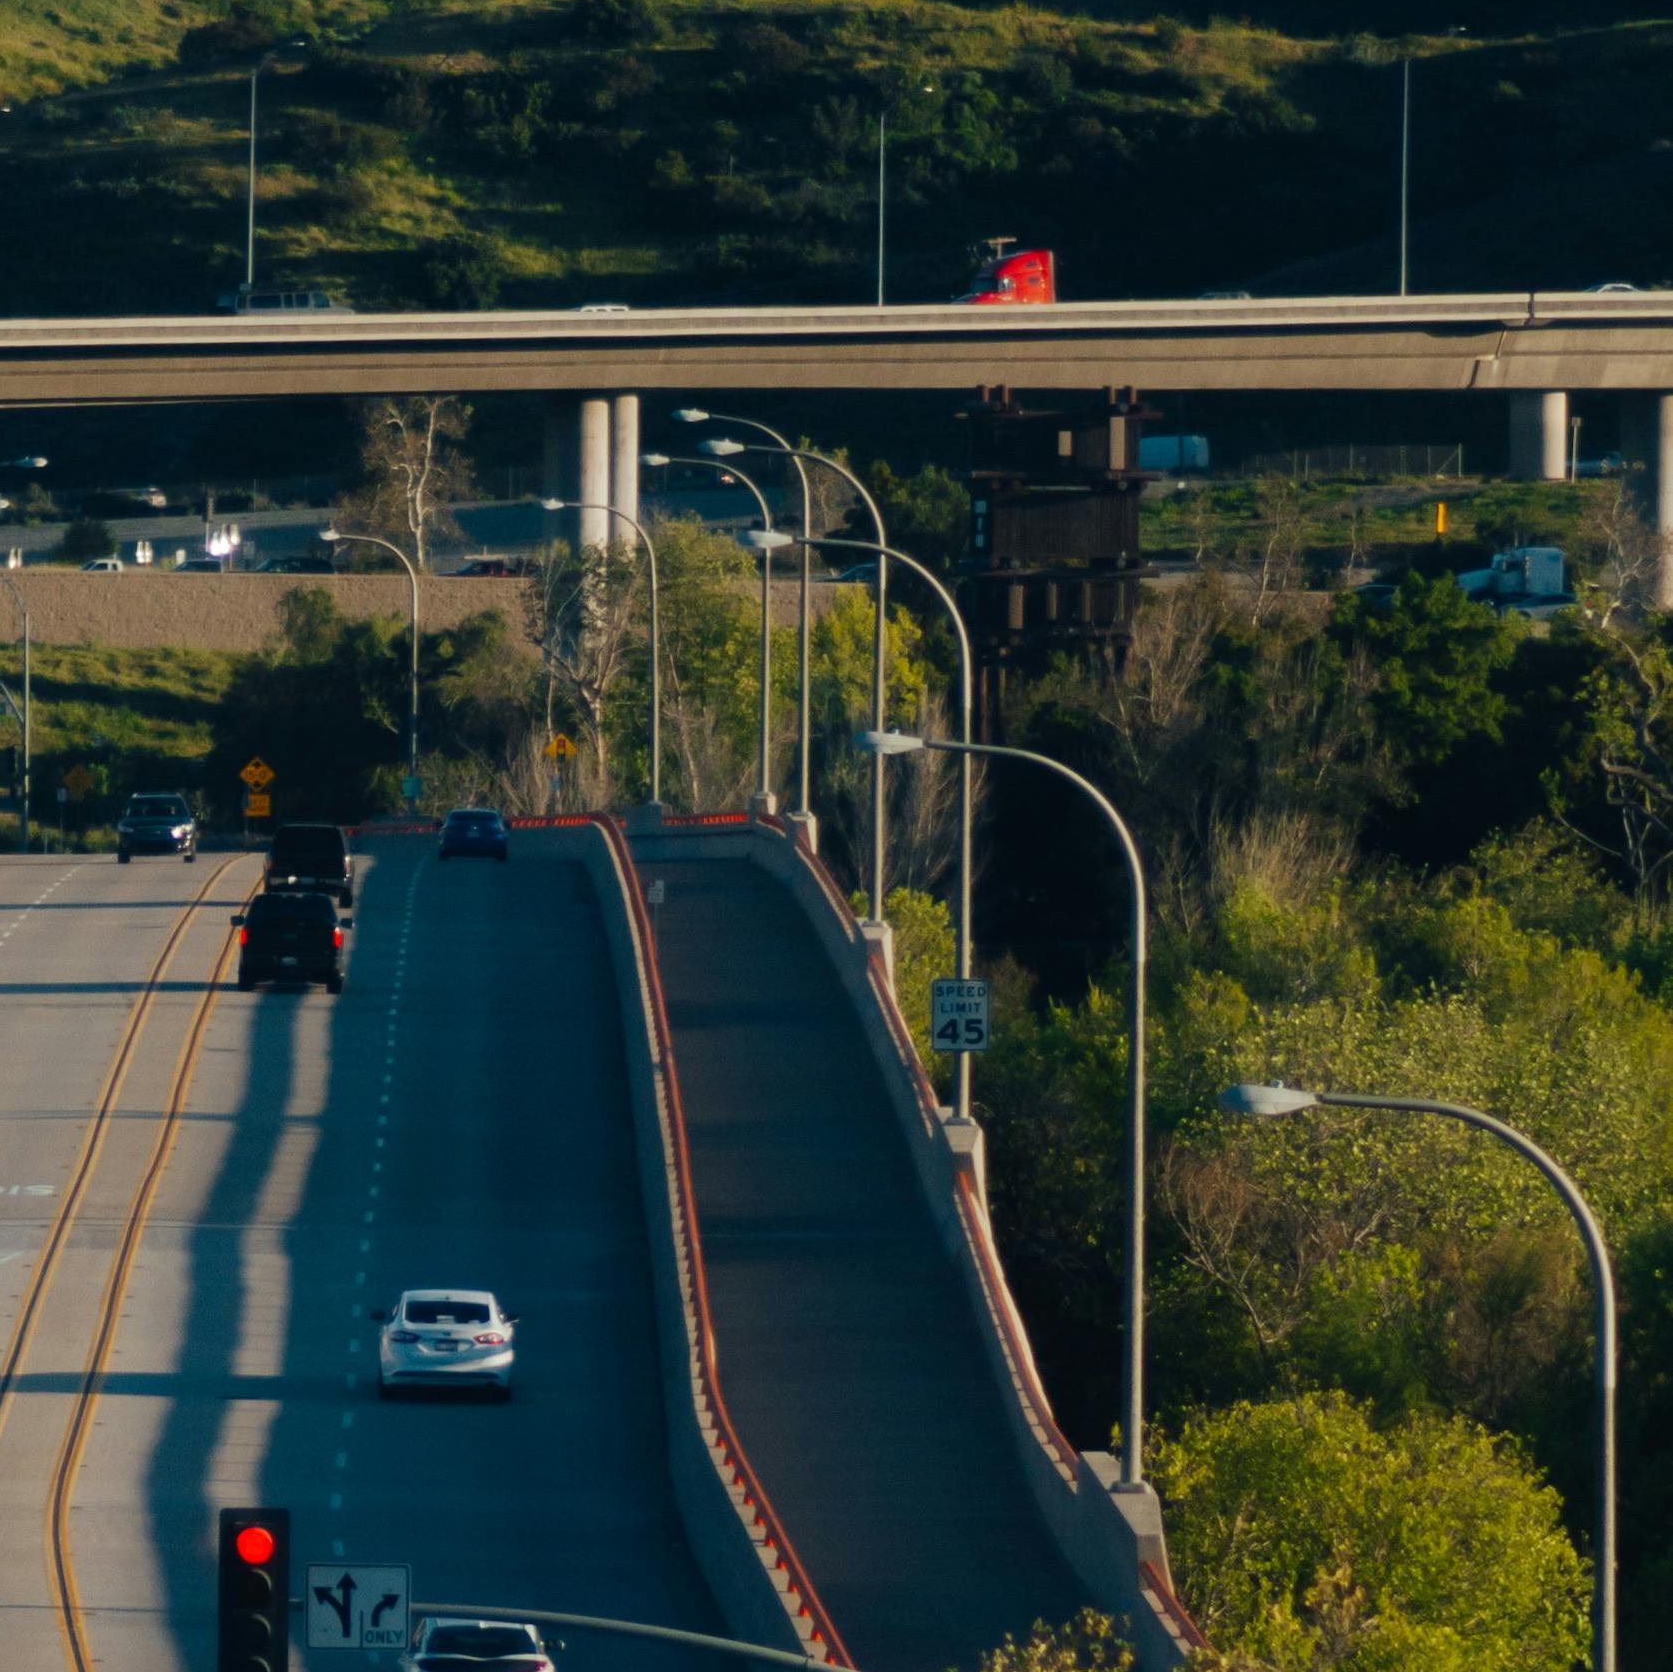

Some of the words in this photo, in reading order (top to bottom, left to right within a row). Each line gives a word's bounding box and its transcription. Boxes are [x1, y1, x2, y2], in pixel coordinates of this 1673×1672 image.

[935, 985, 987, 998] SPEED
[940, 1002, 982, 1014] LIMIT
[936, 1017, 985, 1045] 45
[364, 1630, 404, 1644] ONLY
